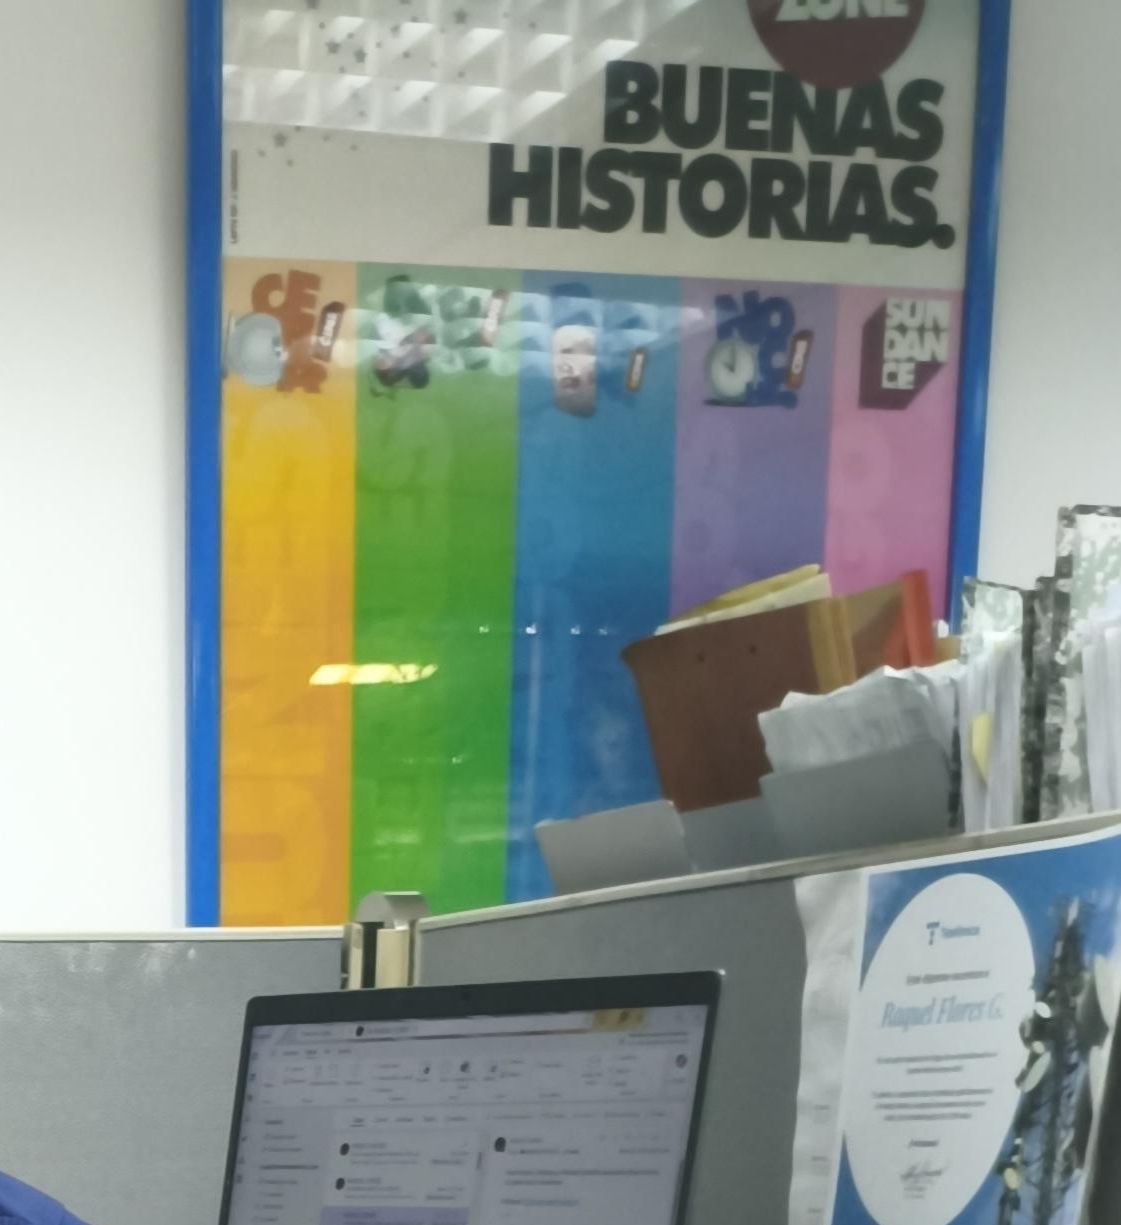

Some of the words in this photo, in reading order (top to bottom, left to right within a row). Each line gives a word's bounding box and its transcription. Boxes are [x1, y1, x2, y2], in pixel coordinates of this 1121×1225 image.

[604, 60, 944, 162] BUENAS
[488, 143, 956, 249] HISTORIAS.
[886, 299, 951, 328] SUN
[884, 328, 949, 362] DAN
[881, 362, 915, 389] CE
